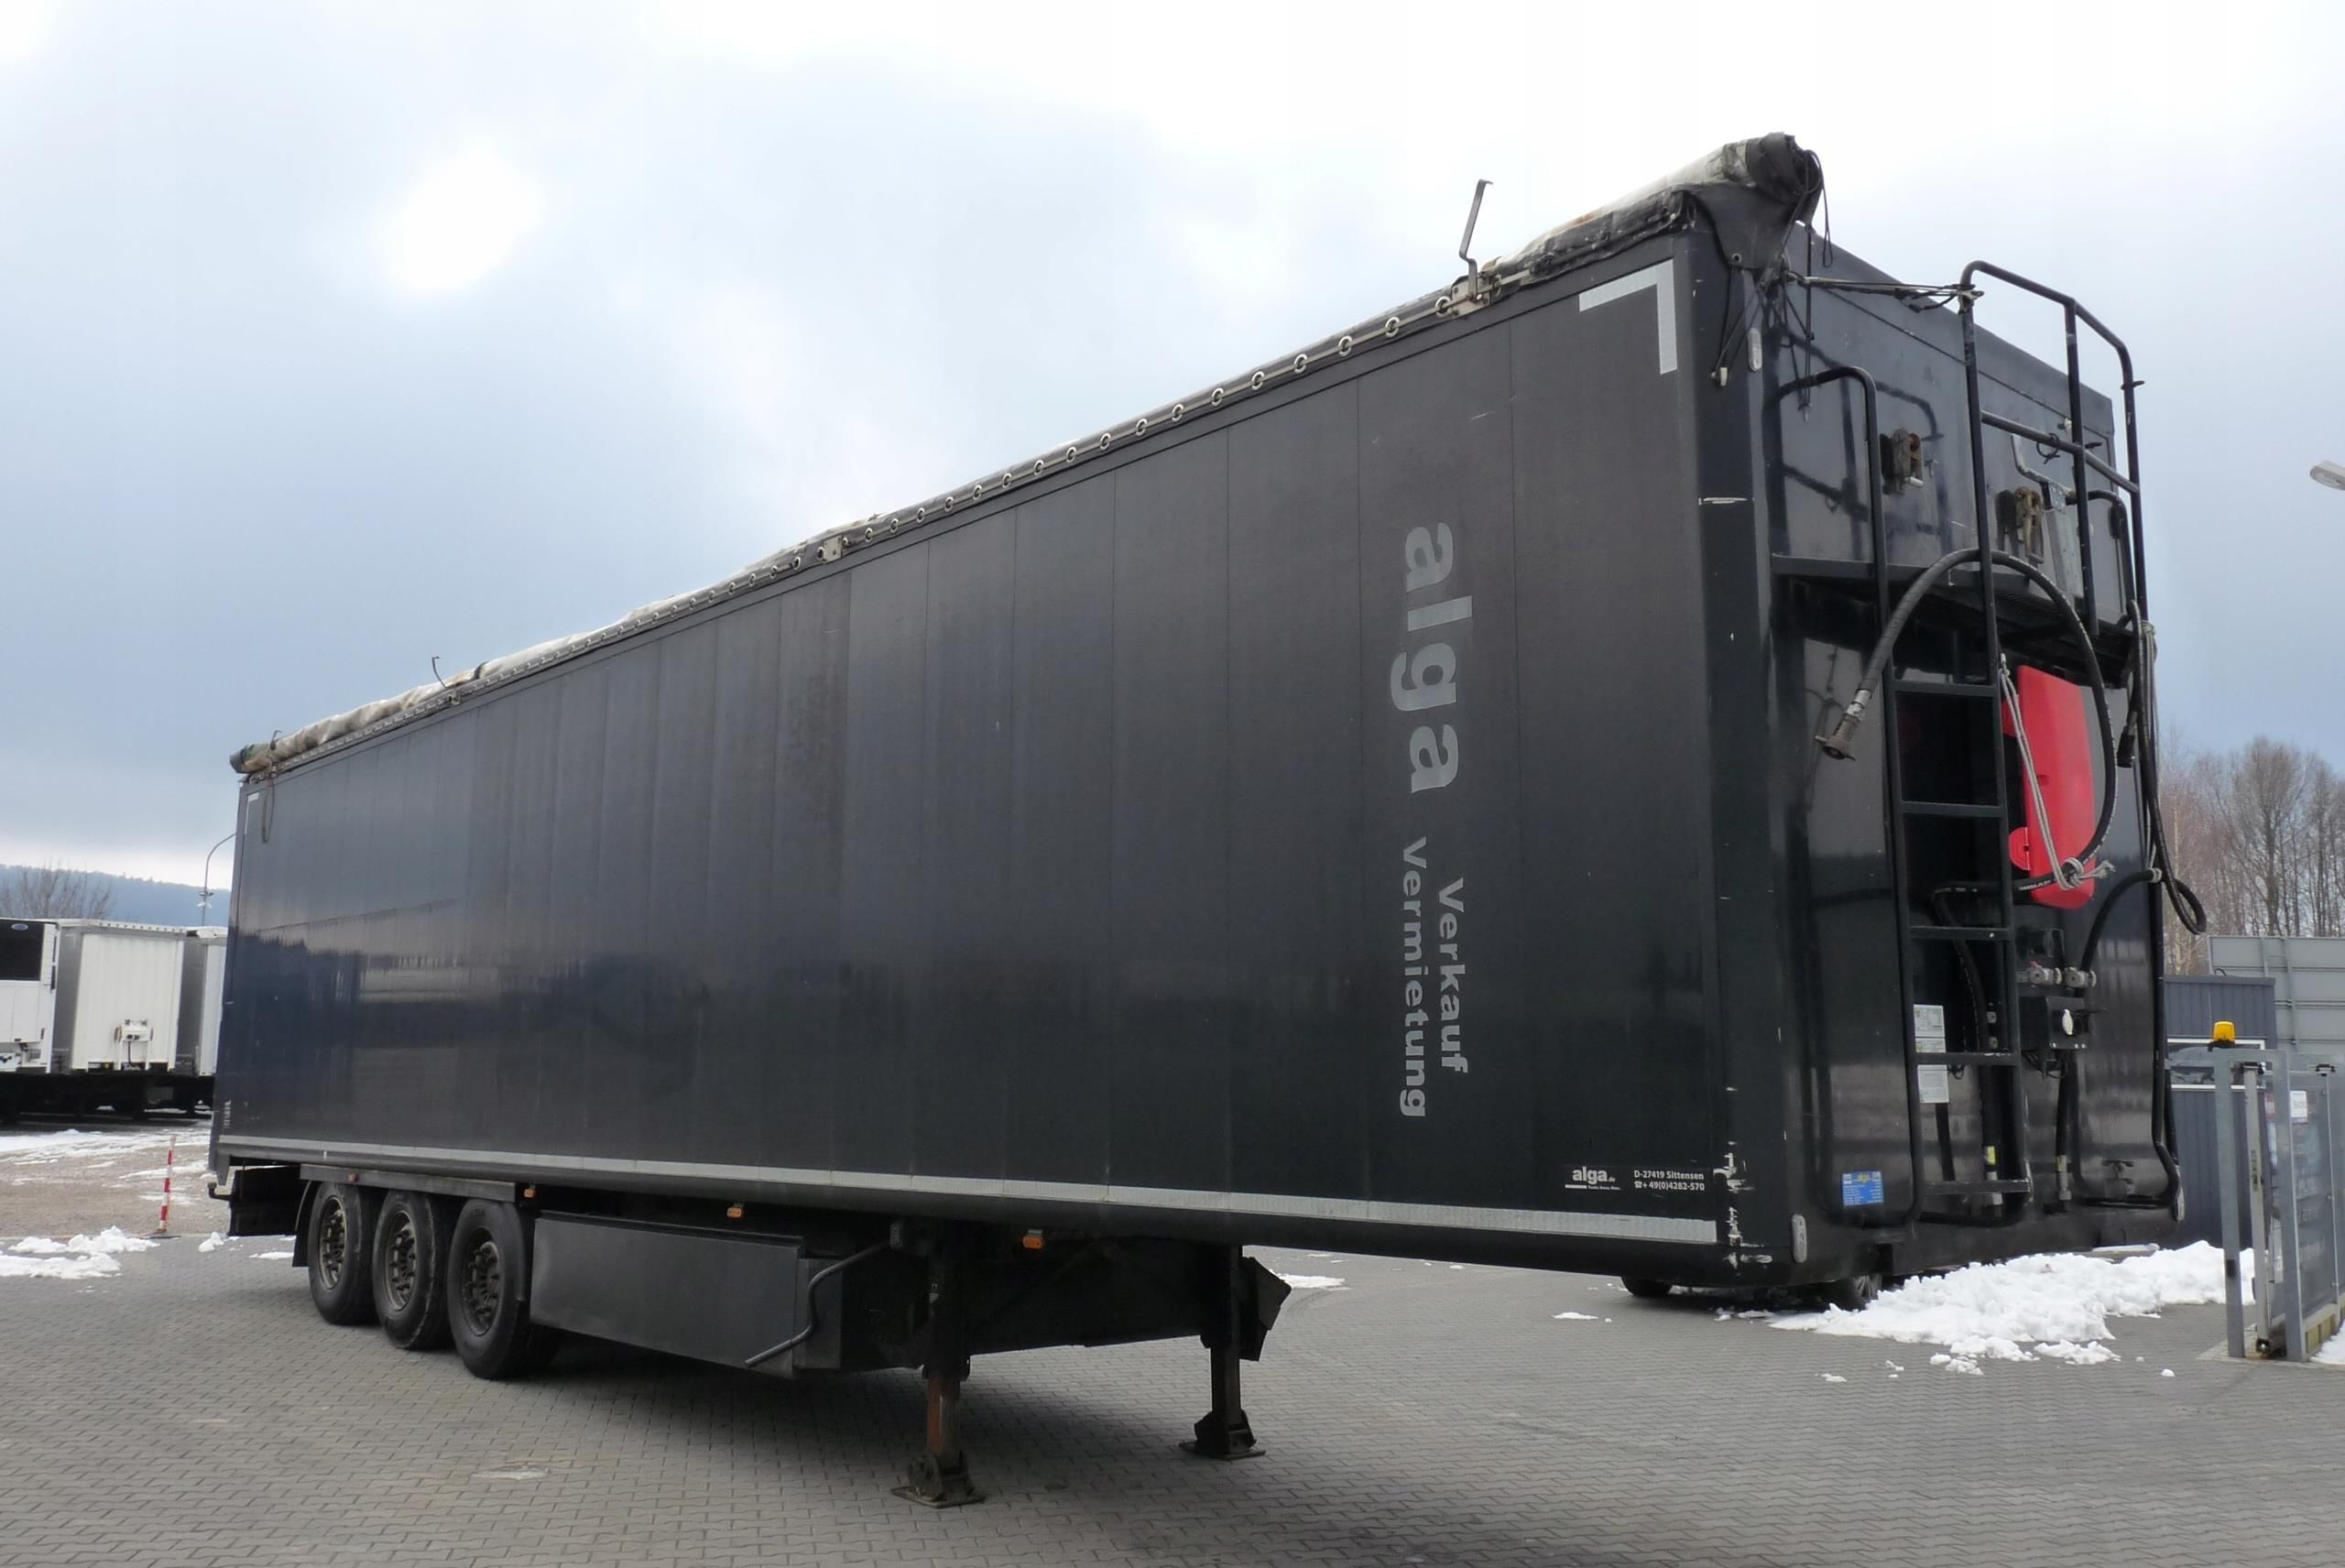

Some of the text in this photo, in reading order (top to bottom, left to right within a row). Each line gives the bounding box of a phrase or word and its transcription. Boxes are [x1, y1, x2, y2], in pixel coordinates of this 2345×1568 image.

[1391, 522, 1472, 794] alga
[1400, 836, 1428, 1117] Vermietung
[1438, 877, 1468, 1073] Verkauf
[1633, 1170, 1704, 1180] D-27419 Sittensen
